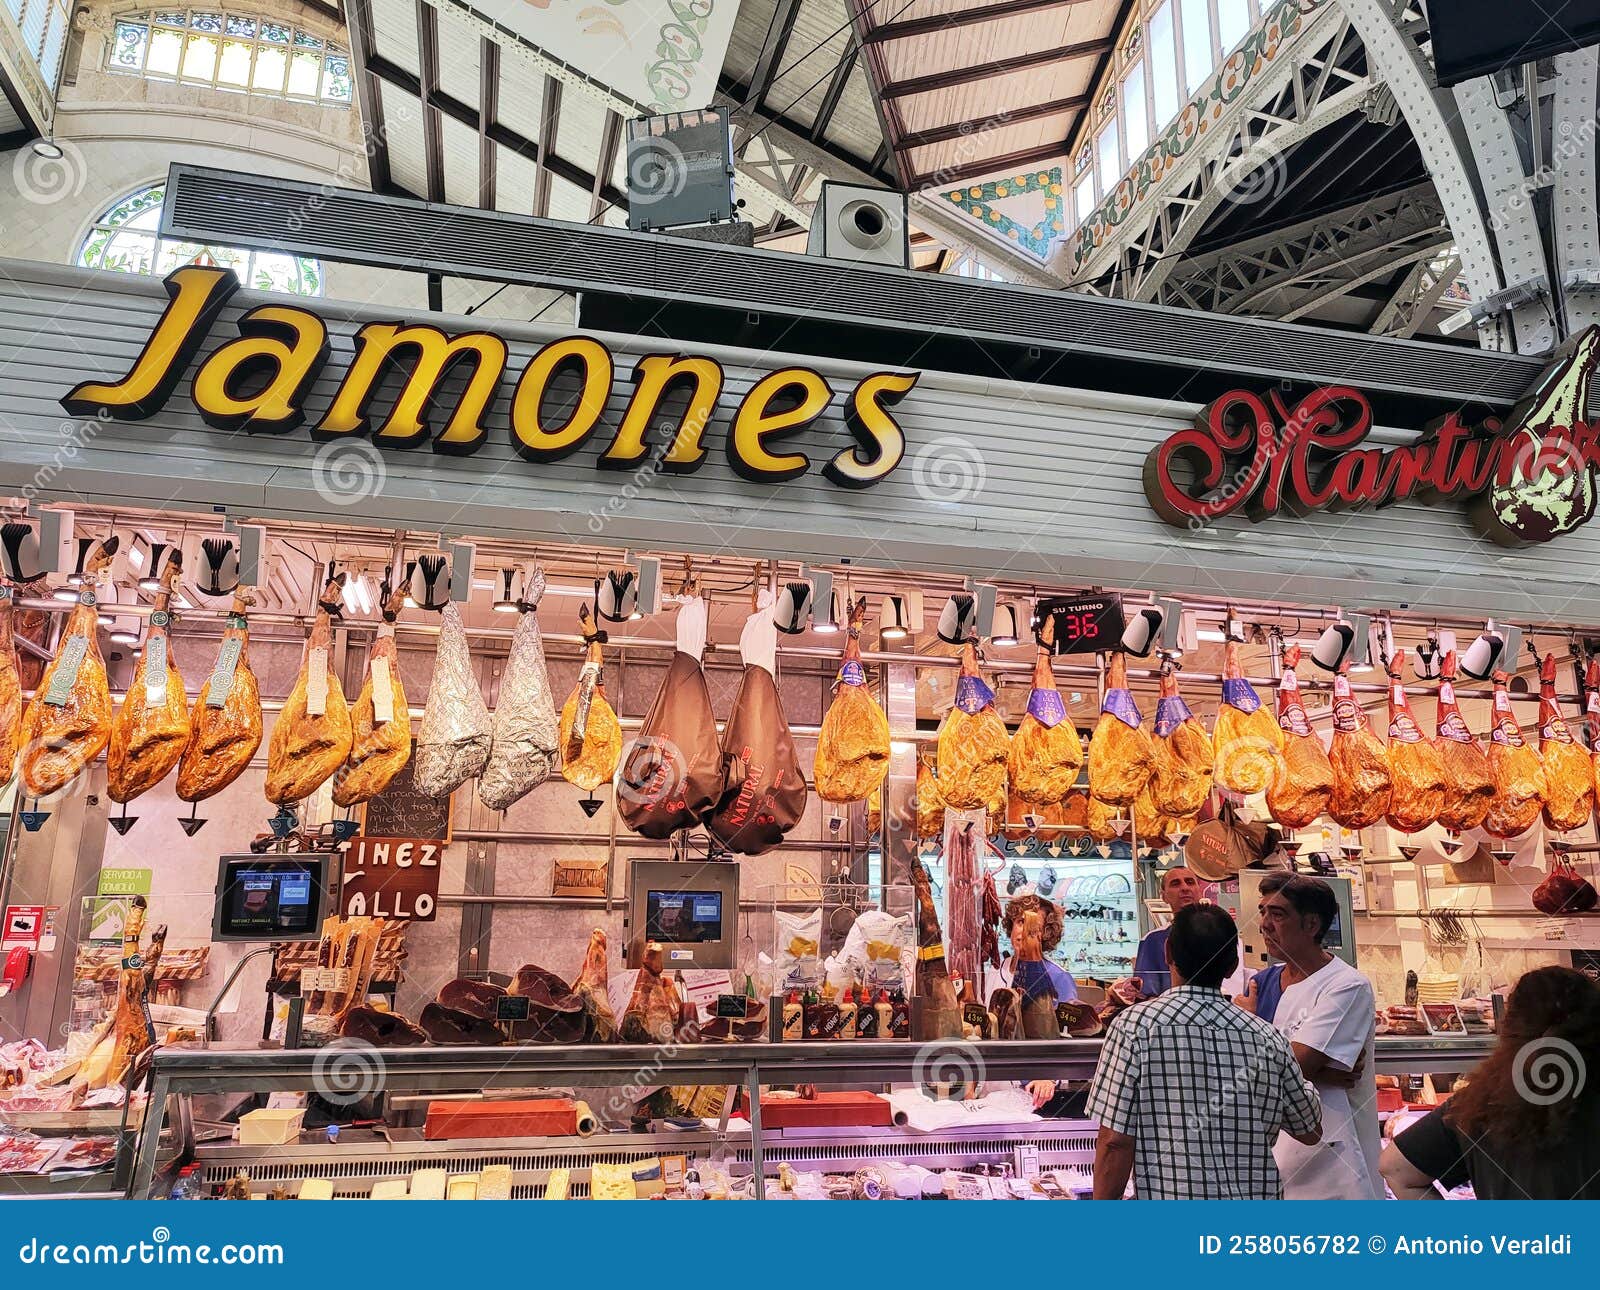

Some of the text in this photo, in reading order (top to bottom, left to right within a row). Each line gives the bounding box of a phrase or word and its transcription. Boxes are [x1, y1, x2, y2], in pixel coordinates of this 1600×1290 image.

[62, 265, 921, 489] Jamones
[1068, 603, 1104, 612] TURNO
[1066, 613, 1099, 639] 36
[730, 763, 765, 827] NATURAL
[824, 1012, 840, 1033] HONEY
